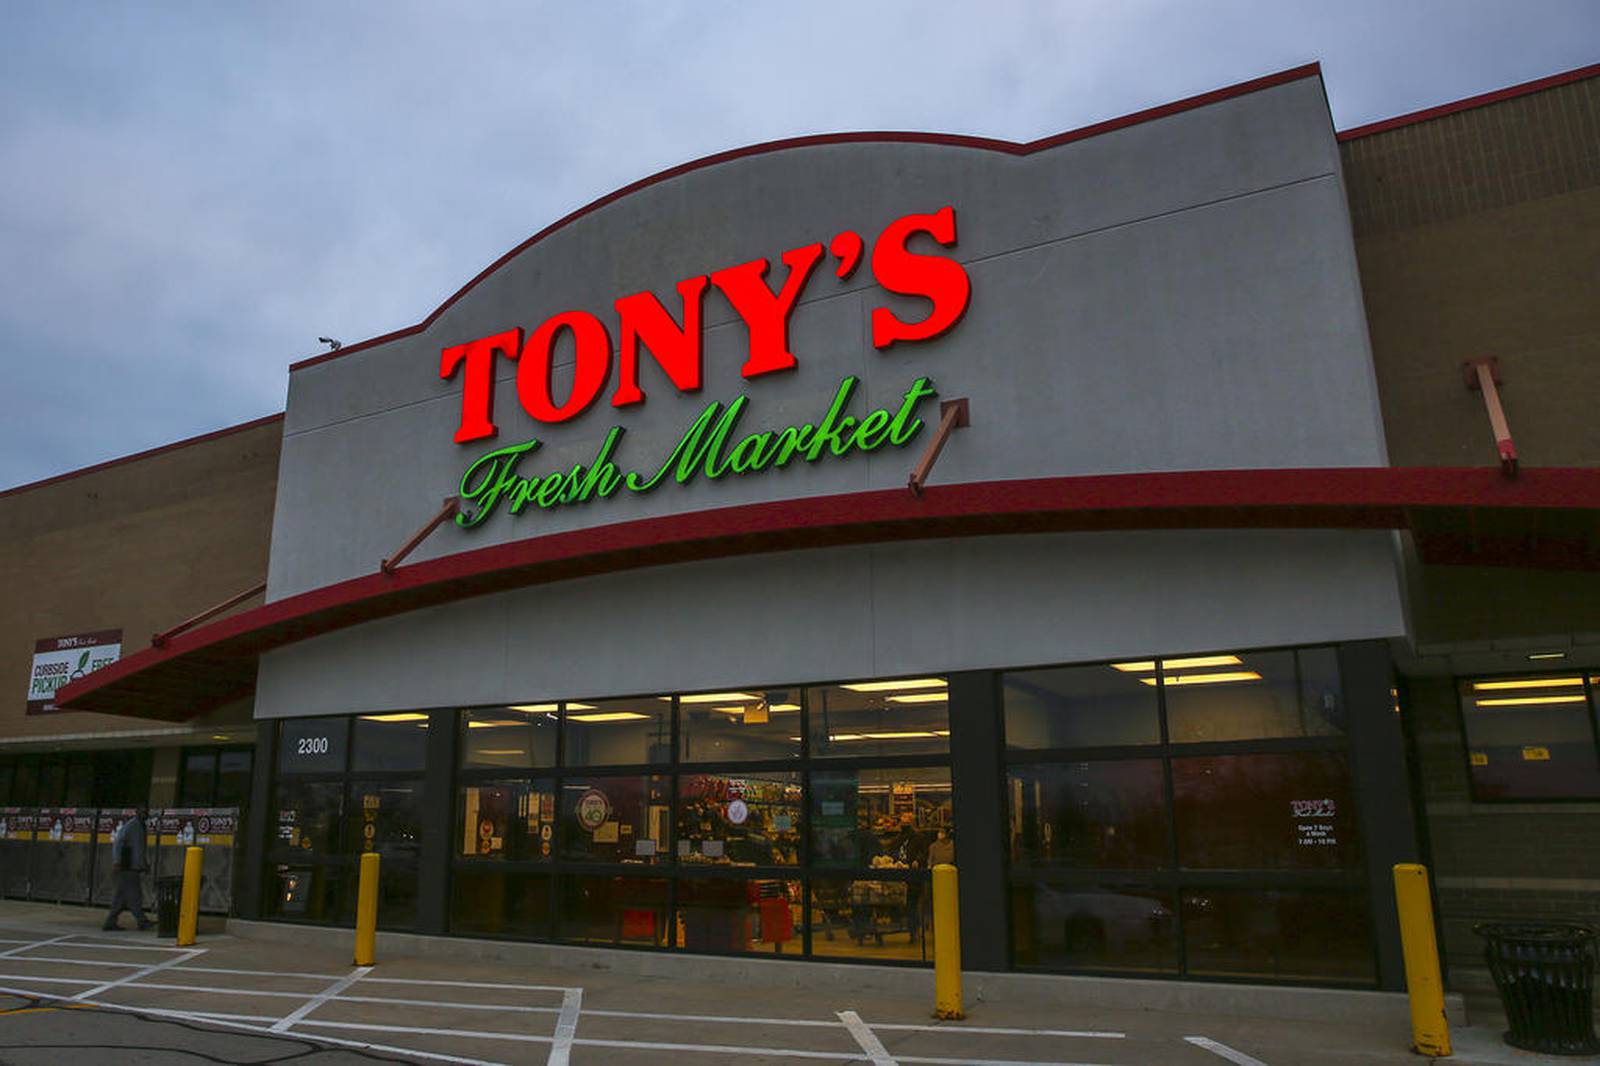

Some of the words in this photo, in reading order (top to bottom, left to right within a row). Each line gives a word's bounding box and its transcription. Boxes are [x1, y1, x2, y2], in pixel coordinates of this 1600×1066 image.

[440, 206, 972, 444] TONY'S
[454, 425, 626, 529] Fresh
[627, 375, 937, 493] Market
[34, 662, 70, 676] CURBSIDE
[298, 737, 328, 754] 2300
